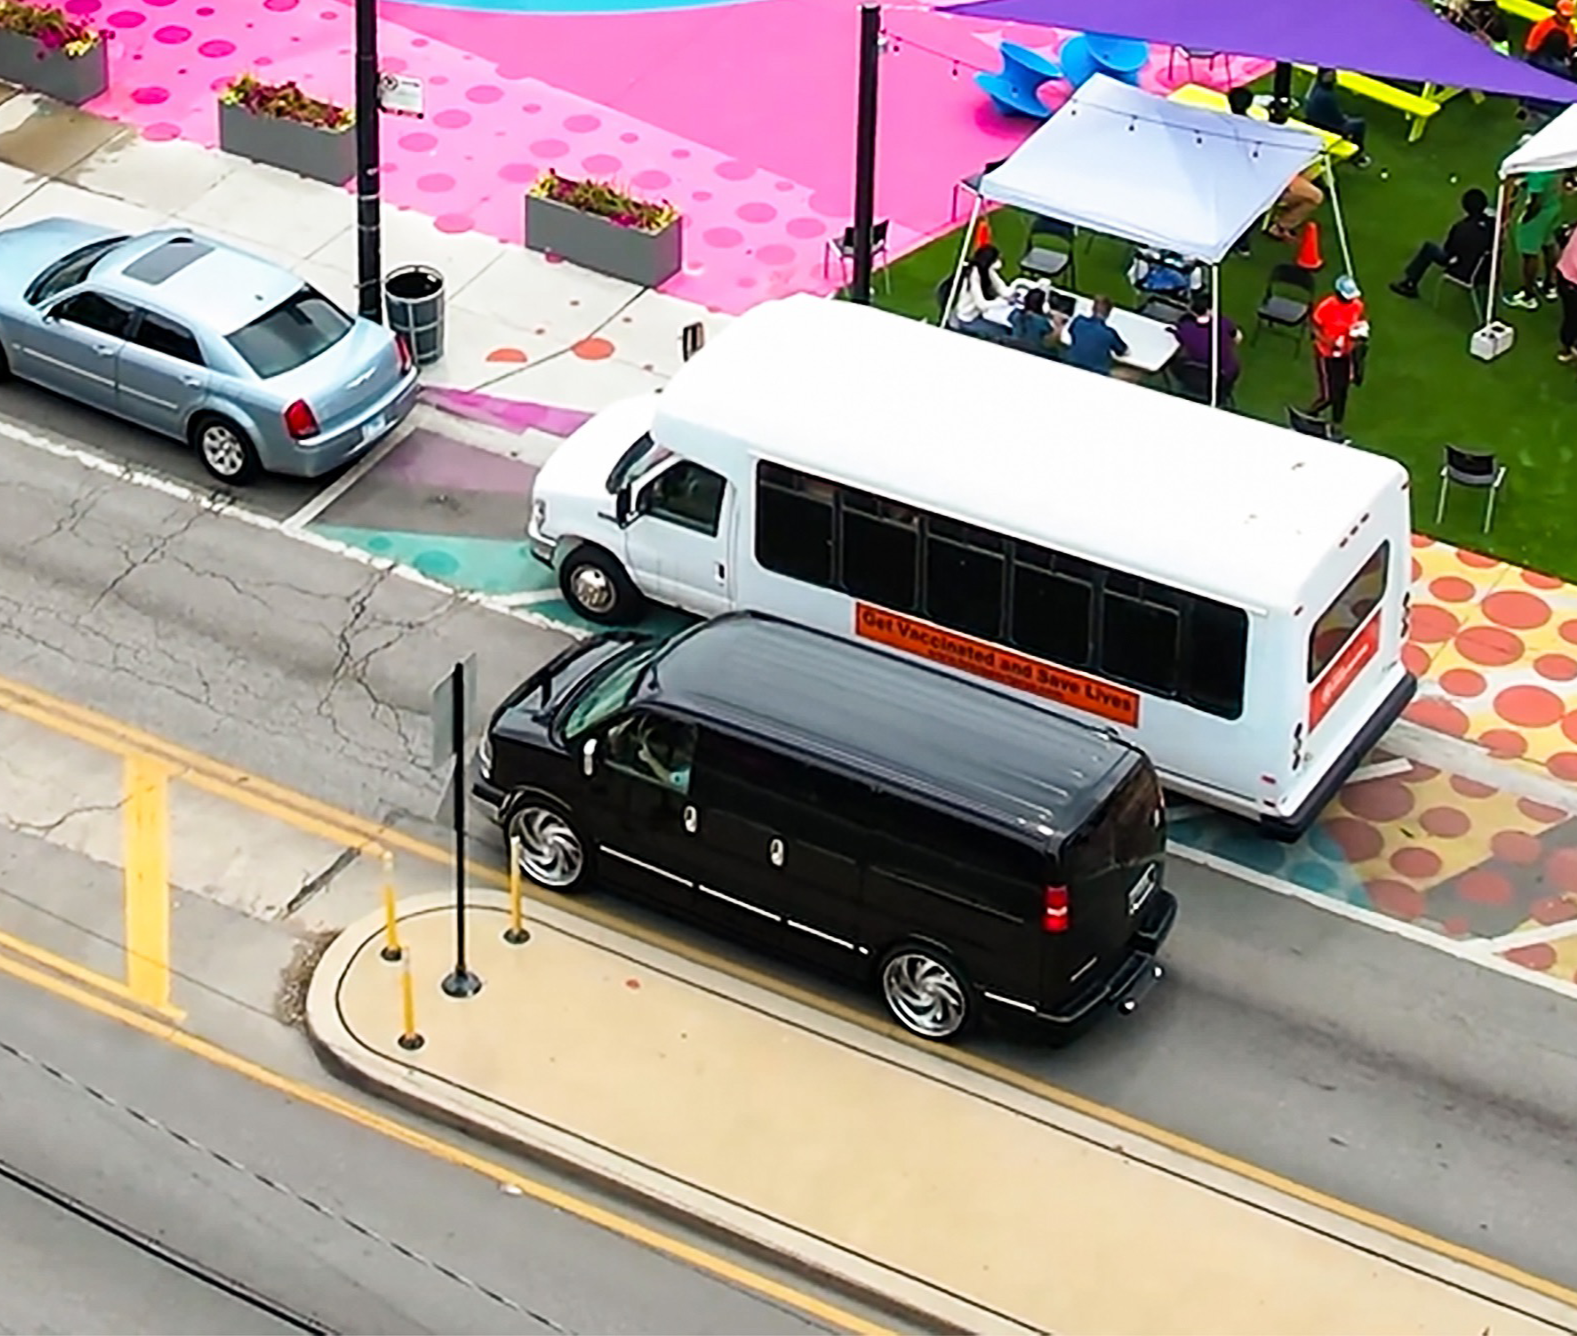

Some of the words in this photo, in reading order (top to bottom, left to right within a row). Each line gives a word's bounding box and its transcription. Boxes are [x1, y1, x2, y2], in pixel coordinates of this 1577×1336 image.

[862, 609, 894, 634] Get
[896, 619, 996, 665] Vaccinated
[999, 654, 1033, 679] and
[1035, 667, 1081, 694] Save
[1084, 683, 1133, 712] Lives
